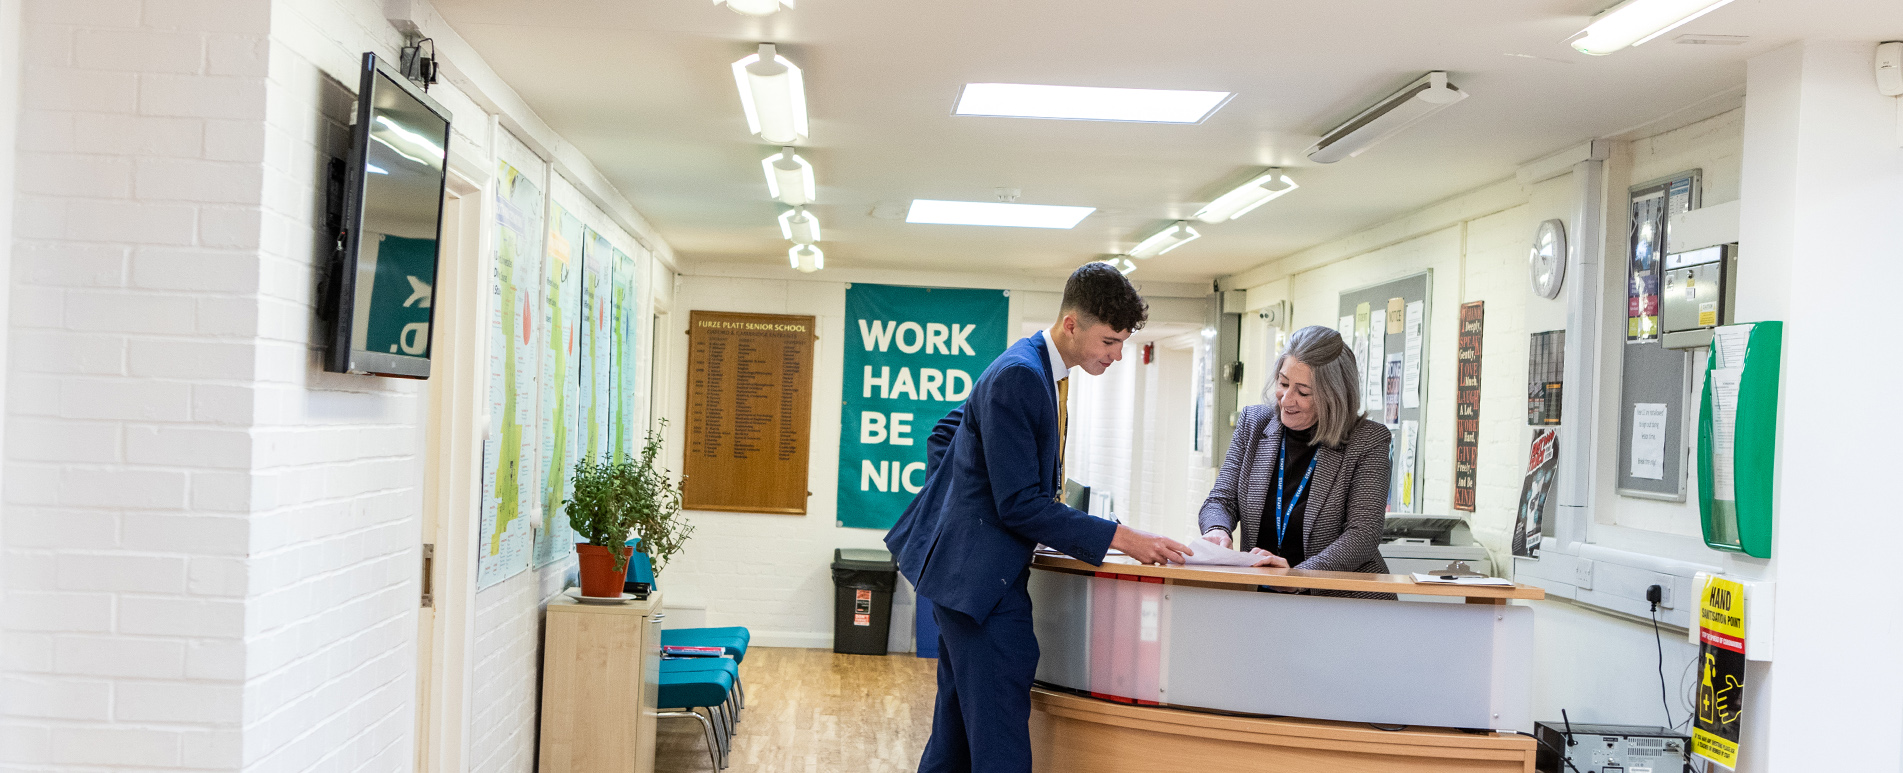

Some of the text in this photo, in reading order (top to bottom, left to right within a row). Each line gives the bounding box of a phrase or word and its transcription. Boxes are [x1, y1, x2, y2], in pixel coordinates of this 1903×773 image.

[1465, 320, 1481, 333] Deeply,
[858, 319, 976, 356] WORK
[1460, 336, 1480, 356] SPEAK
[1459, 348, 1476, 362] Gently,
[864, 366, 973, 402] HARD
[1460, 362, 1478, 386] LOVE
[1458, 390, 1479, 410] LAUGH
[1464, 405, 1473, 417] Lot,
[860, 411, 914, 446] BE
[1458, 420, 1478, 438] WORK
[1464, 432, 1475, 443] Hard,
[1458, 446, 1477, 468] GIVE
[861, 460, 926, 494] NIC
[1467, 477, 1472, 487] Be
[1456, 488, 1474, 505] KIND
[1710, 586, 1731, 611] HAND
[1727, 616, 1740, 628] POINT
